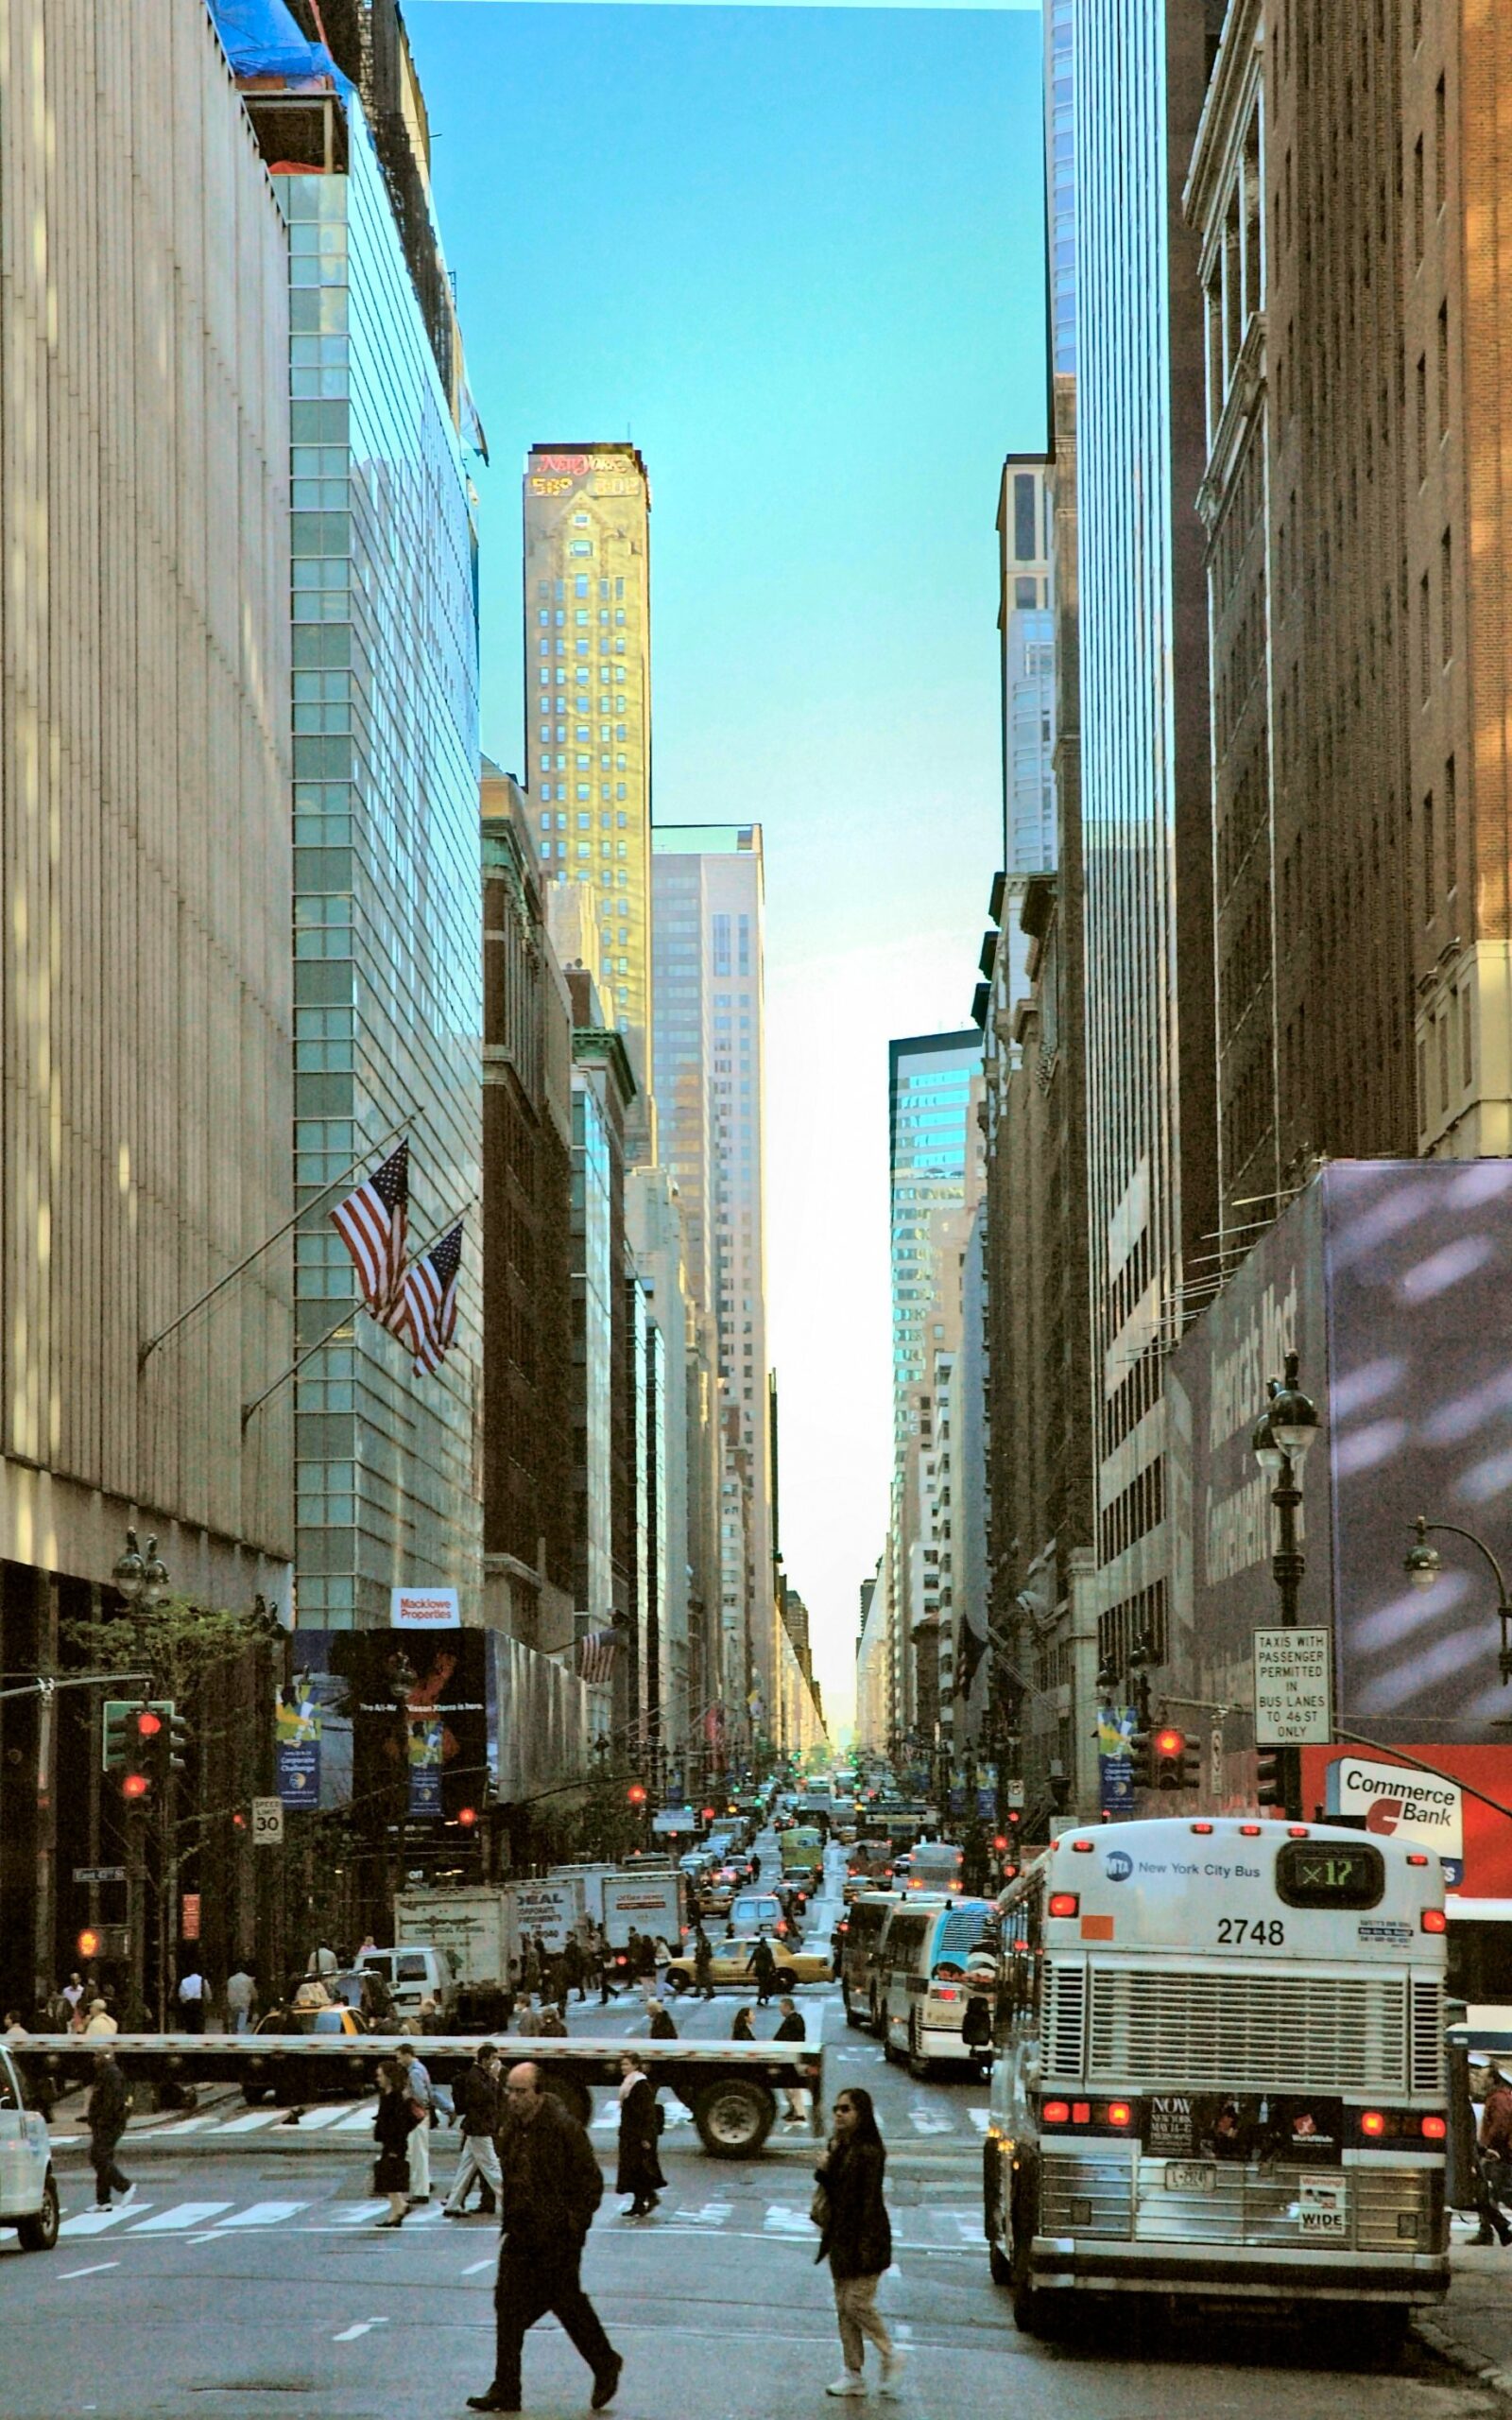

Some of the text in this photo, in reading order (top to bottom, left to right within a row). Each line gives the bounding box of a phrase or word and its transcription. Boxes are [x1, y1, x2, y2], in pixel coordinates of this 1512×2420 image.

[400, 1599, 451, 1609] Macklowe
[401, 1609, 452, 1620] Properties
[1260, 1635, 1324, 1648] TAXIS WITH
[1259, 1651, 1324, 1663] PASSENGER
[1261, 1666, 1322, 1678] PERMITTED
[1286, 1681, 1297, 1692] IN
[1260, 1696, 1325, 1708] BUS LANES
[1266, 1711, 1317, 1722] TO 46 ST
[1278, 1726, 1307, 1737] ONLY
[1347, 1771, 1455, 1806] Commerce
[1402, 1803, 1452, 1826] Bank
[256, 1816, 279, 1831] 30
[1139, 1862, 1262, 1879] New York City Bus
[1217, 1919, 1284, 1945] 2748
[1152, 2097, 1193, 2115] NOW
[1302, 2213, 1343, 2225] WIDE
